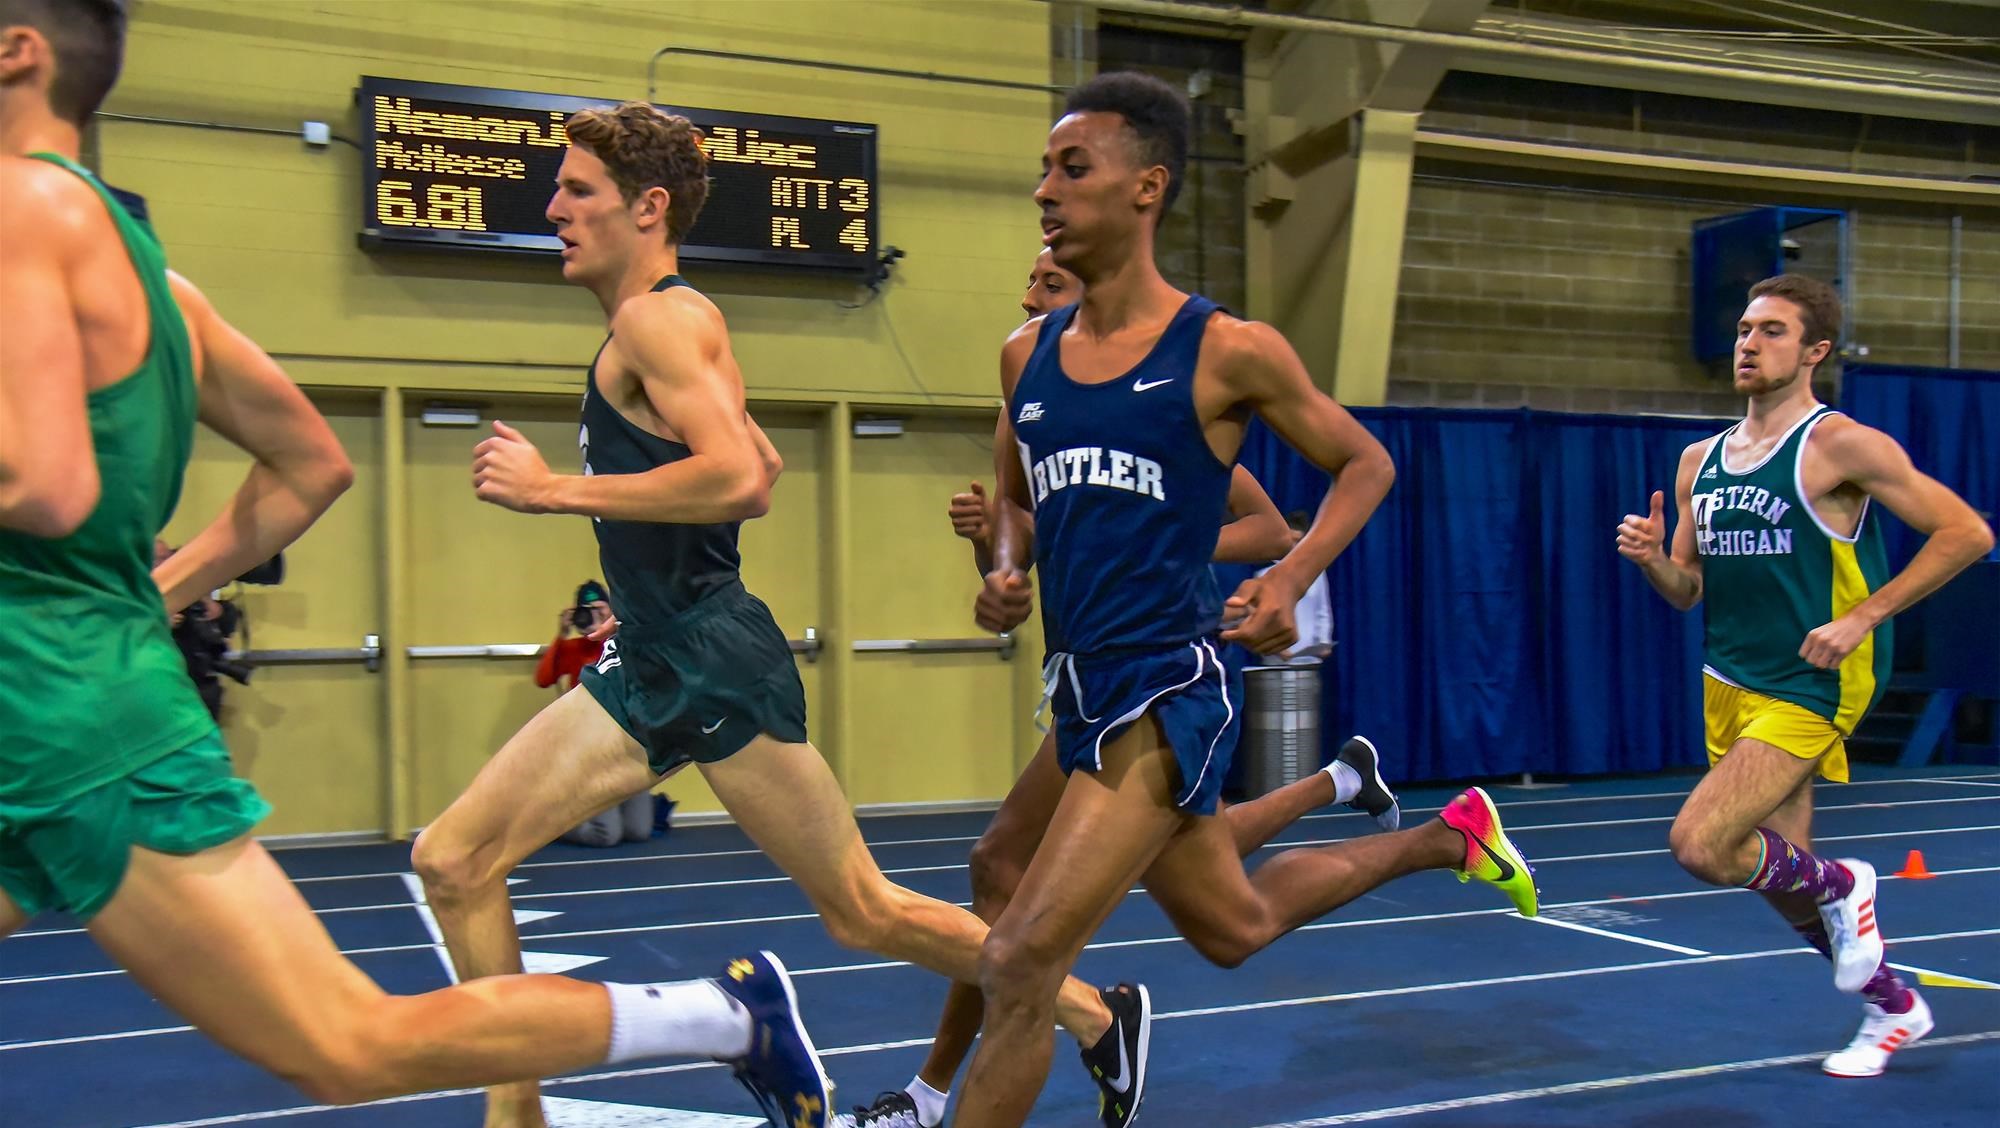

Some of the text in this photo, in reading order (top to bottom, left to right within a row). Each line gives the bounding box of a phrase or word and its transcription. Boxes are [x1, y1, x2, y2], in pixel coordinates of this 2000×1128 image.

[375, 95, 573, 148] Nemanj
[375, 139, 526, 180] McNeese
[376, 180, 488, 231] 6.81
[771, 176, 869, 213] ATT 3
[771, 216, 870, 252] PL 4
[1032, 446, 1166, 504] BUTLER
[1711, 485, 1792, 526] STERN
